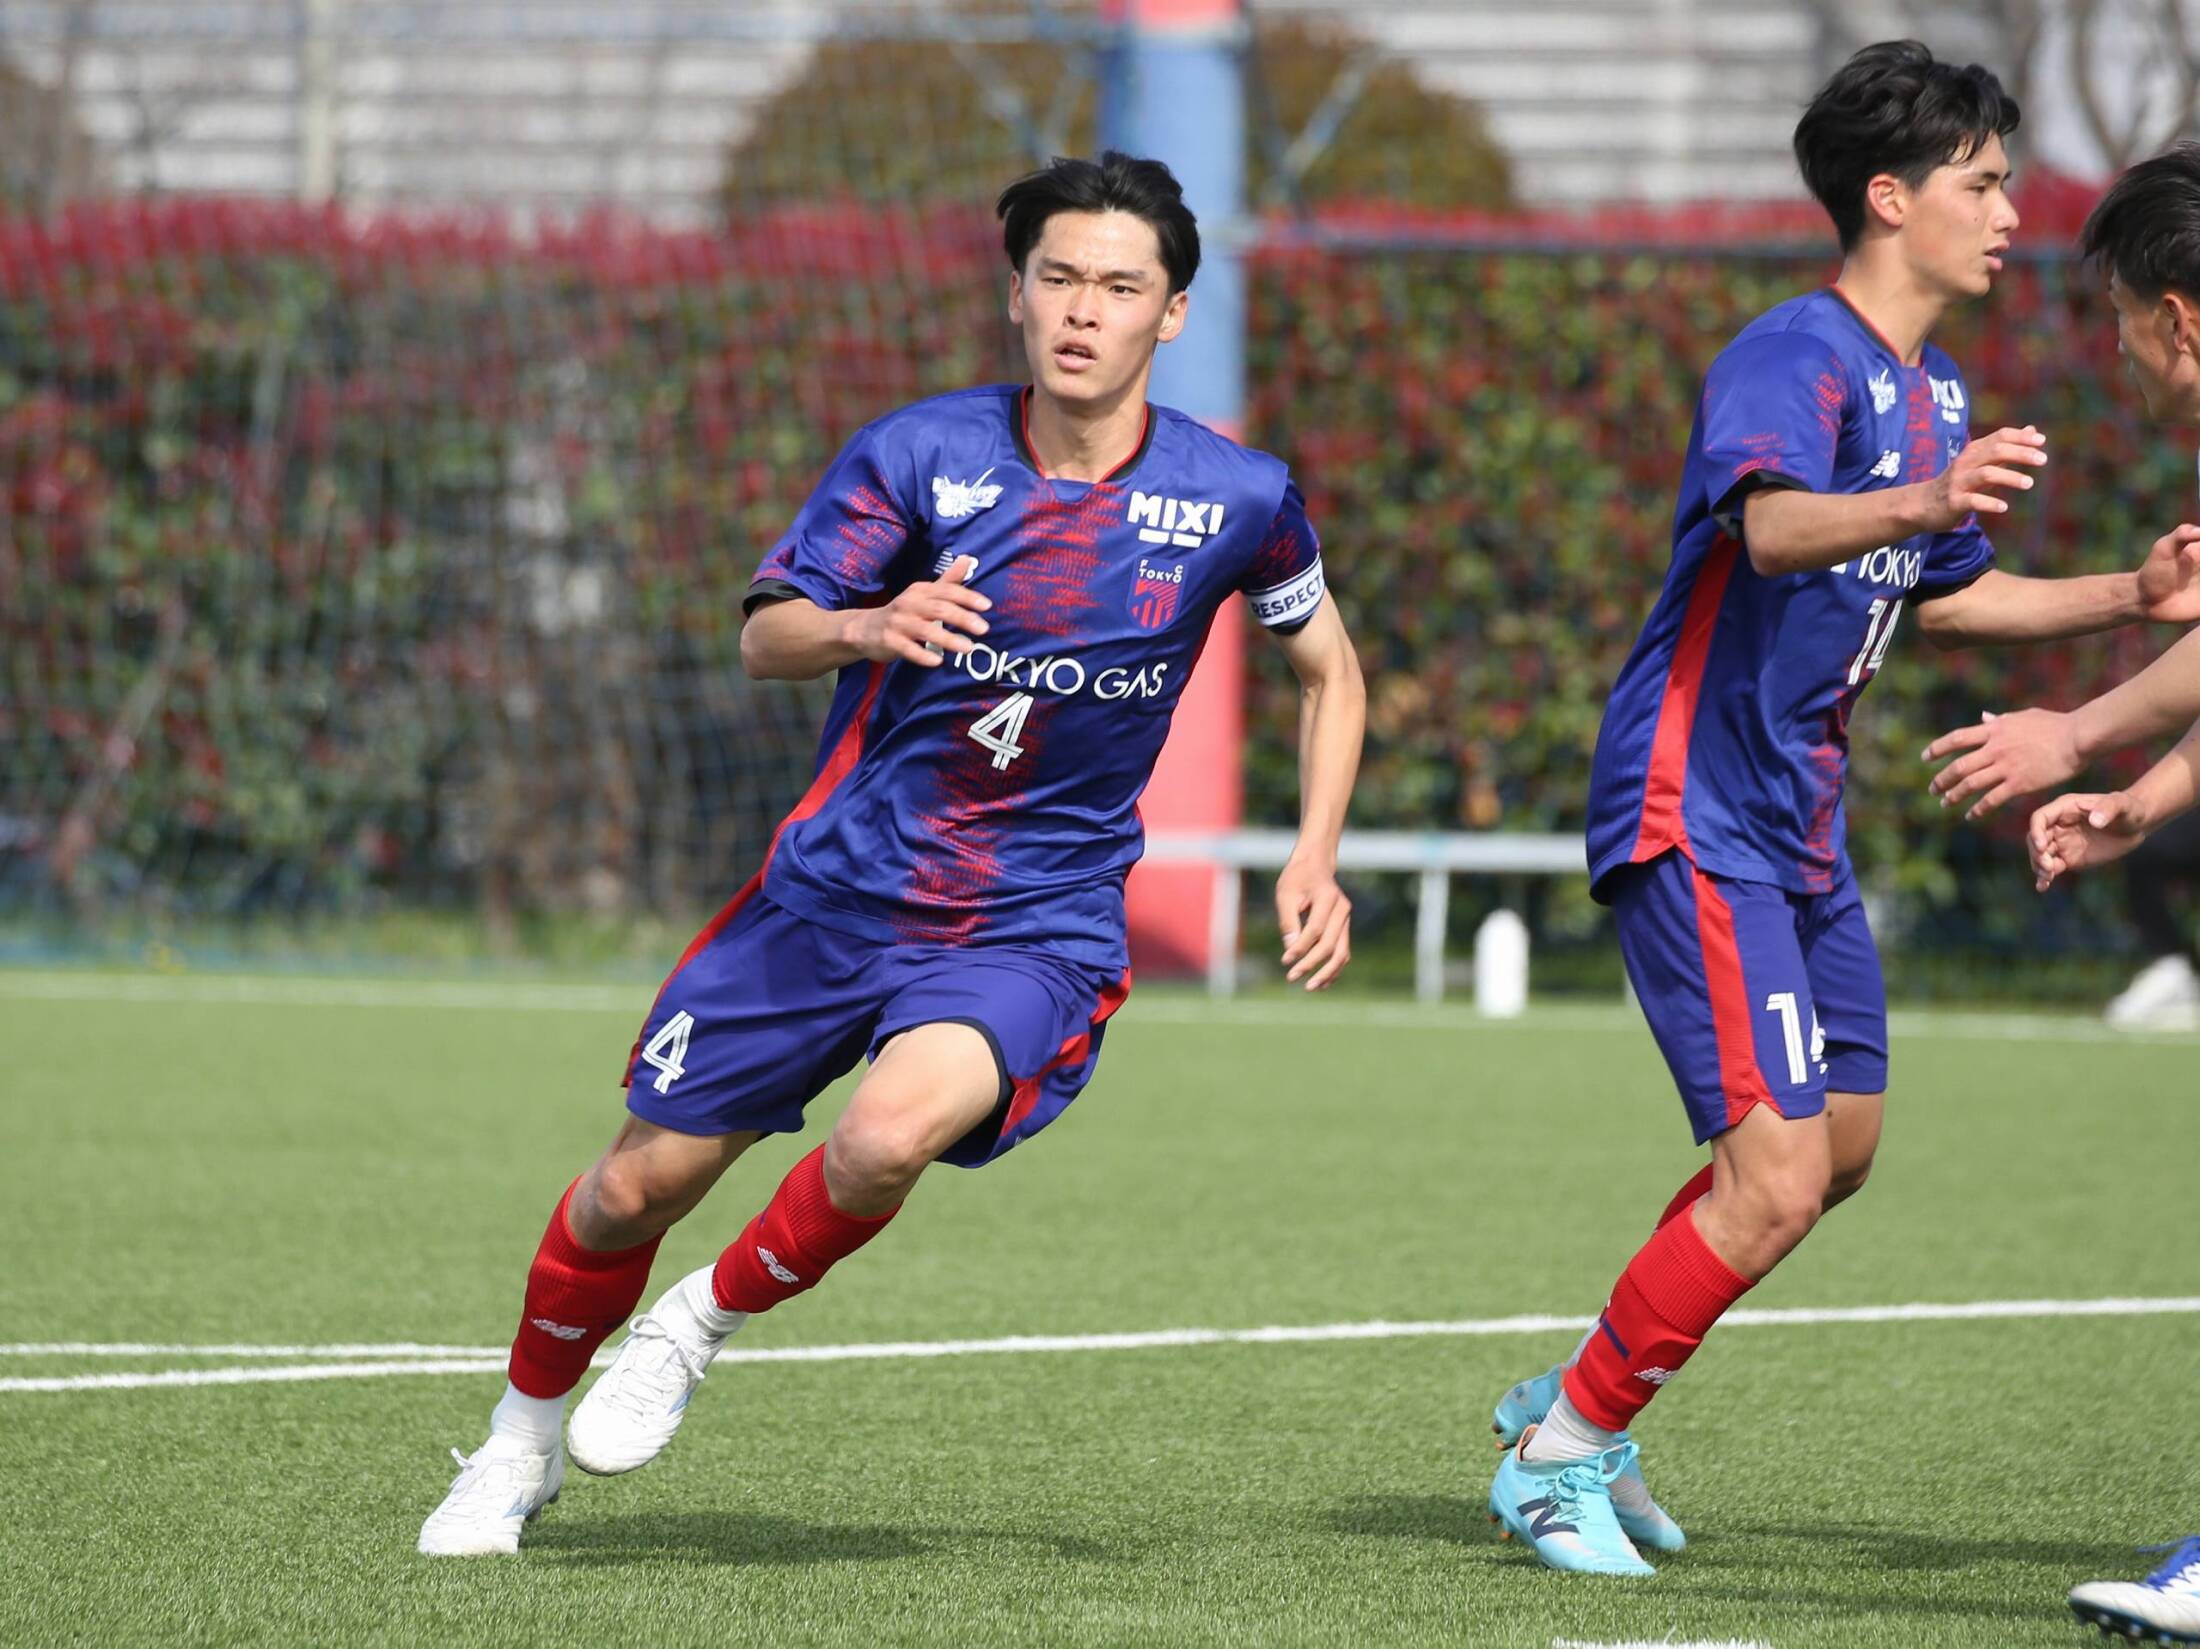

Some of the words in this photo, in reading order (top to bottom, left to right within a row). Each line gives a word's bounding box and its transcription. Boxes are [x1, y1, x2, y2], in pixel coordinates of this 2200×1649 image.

[1127, 491, 1224, 535] MIXI
[1139, 568, 1182, 583] TOKYO
[1251, 574, 1322, 618] RESPECT
[1848, 598, 1904, 685] 14
[1093, 662, 1168, 699] GAS
[967, 691, 1034, 771] 4
[642, 1010, 695, 1094] 4
